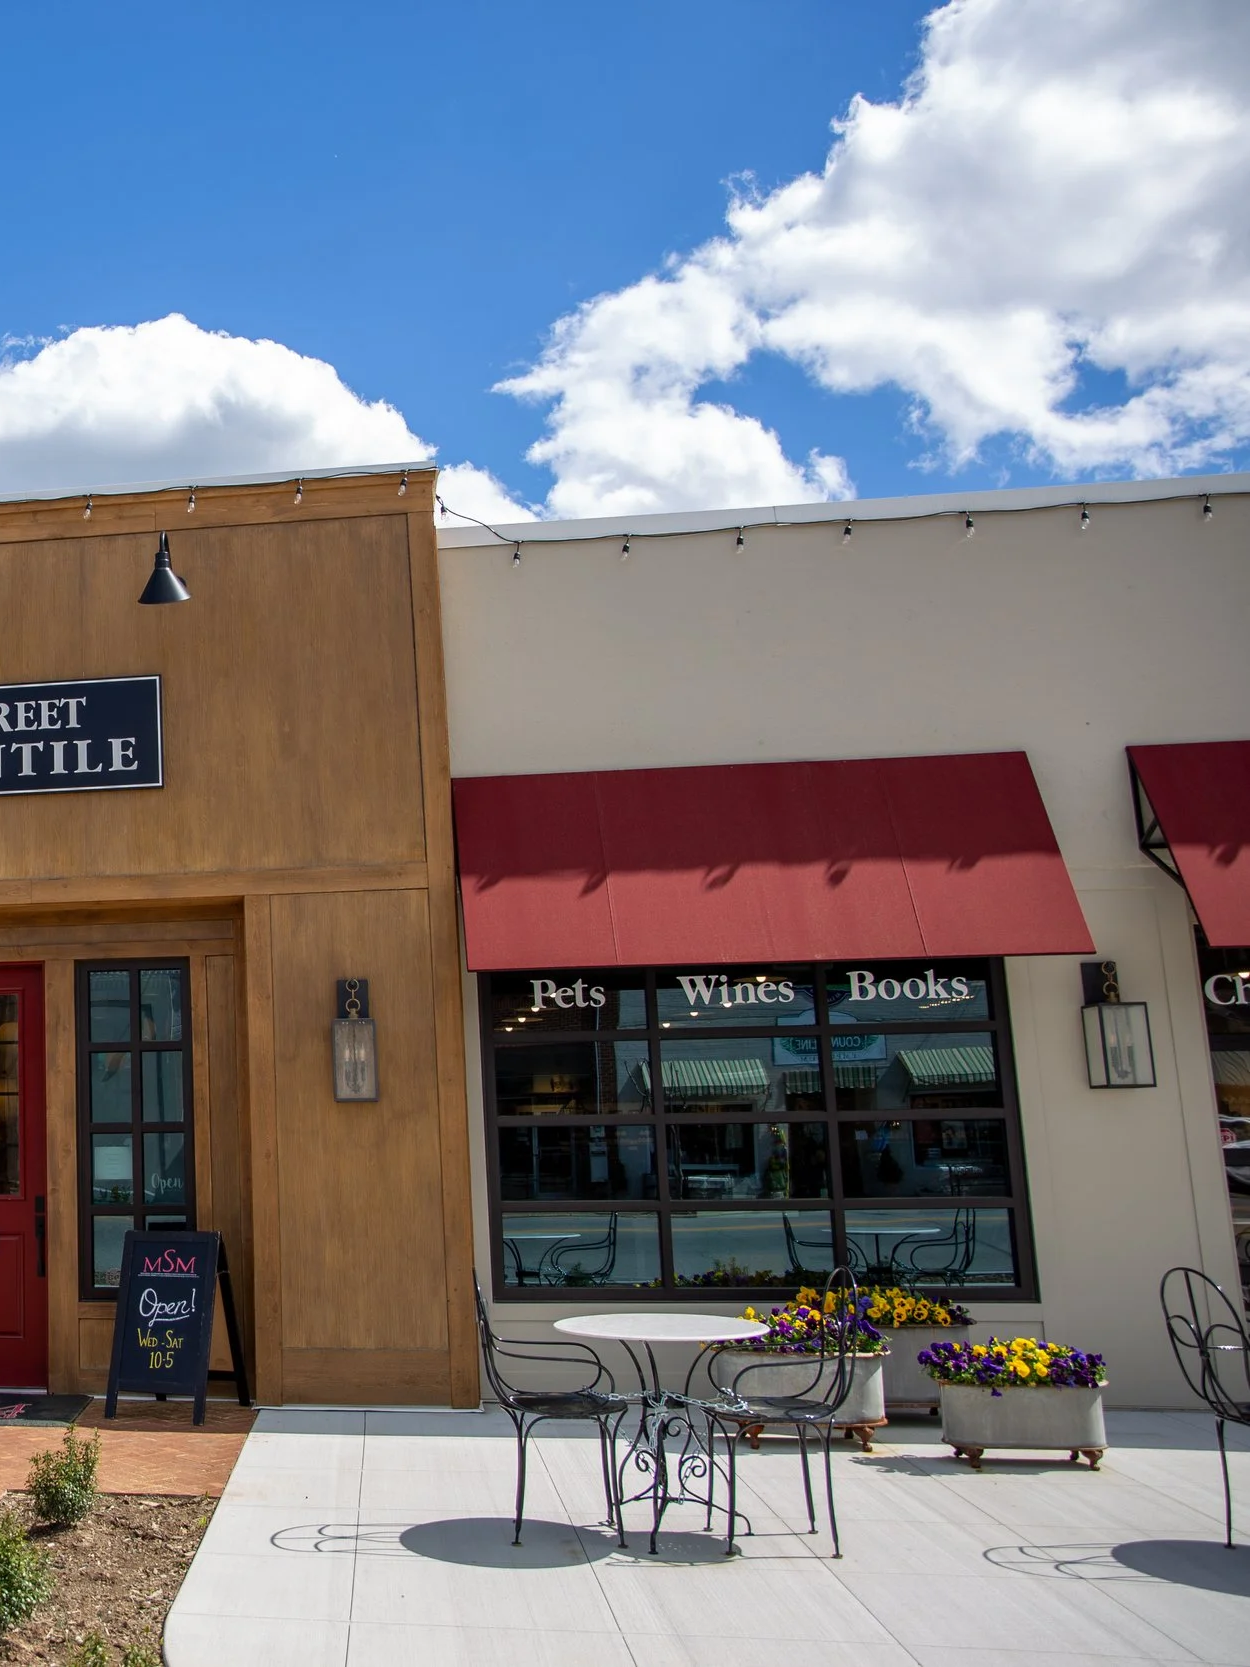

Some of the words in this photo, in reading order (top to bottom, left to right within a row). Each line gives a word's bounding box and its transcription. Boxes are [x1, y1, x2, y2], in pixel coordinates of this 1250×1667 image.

[530, 978, 606, 1009] Pets
[676, 974, 795, 1006] Wines
[847, 969, 970, 1002] Books
[151, 1173, 183, 1194] Open
[143, 1249, 196, 1274] MSM
[139, 1288, 196, 1327] Open!
